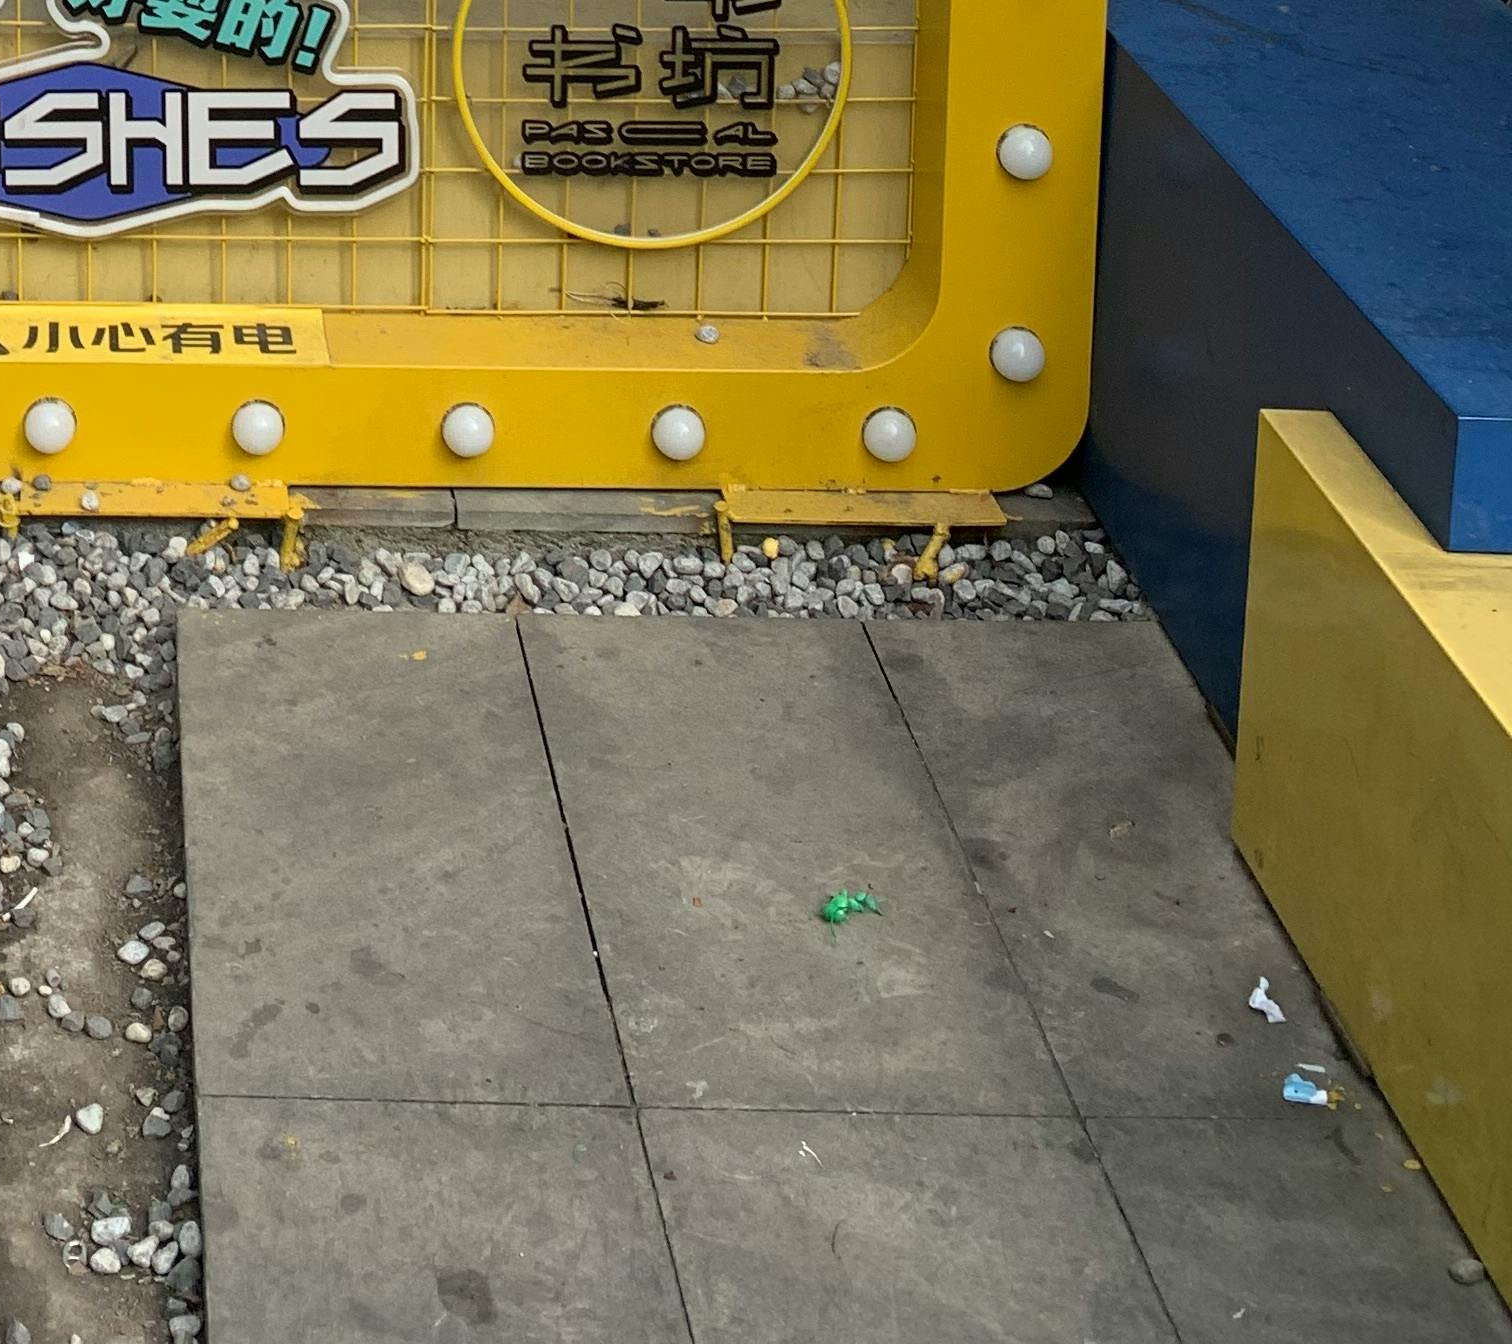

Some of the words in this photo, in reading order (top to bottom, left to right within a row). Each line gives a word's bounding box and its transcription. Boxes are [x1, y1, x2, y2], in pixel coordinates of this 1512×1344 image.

[522, 23, 780, 109] 书坊
[521, 151, 778, 177] BOOKSTORE
[22, 321, 297, 355] 小心有电
